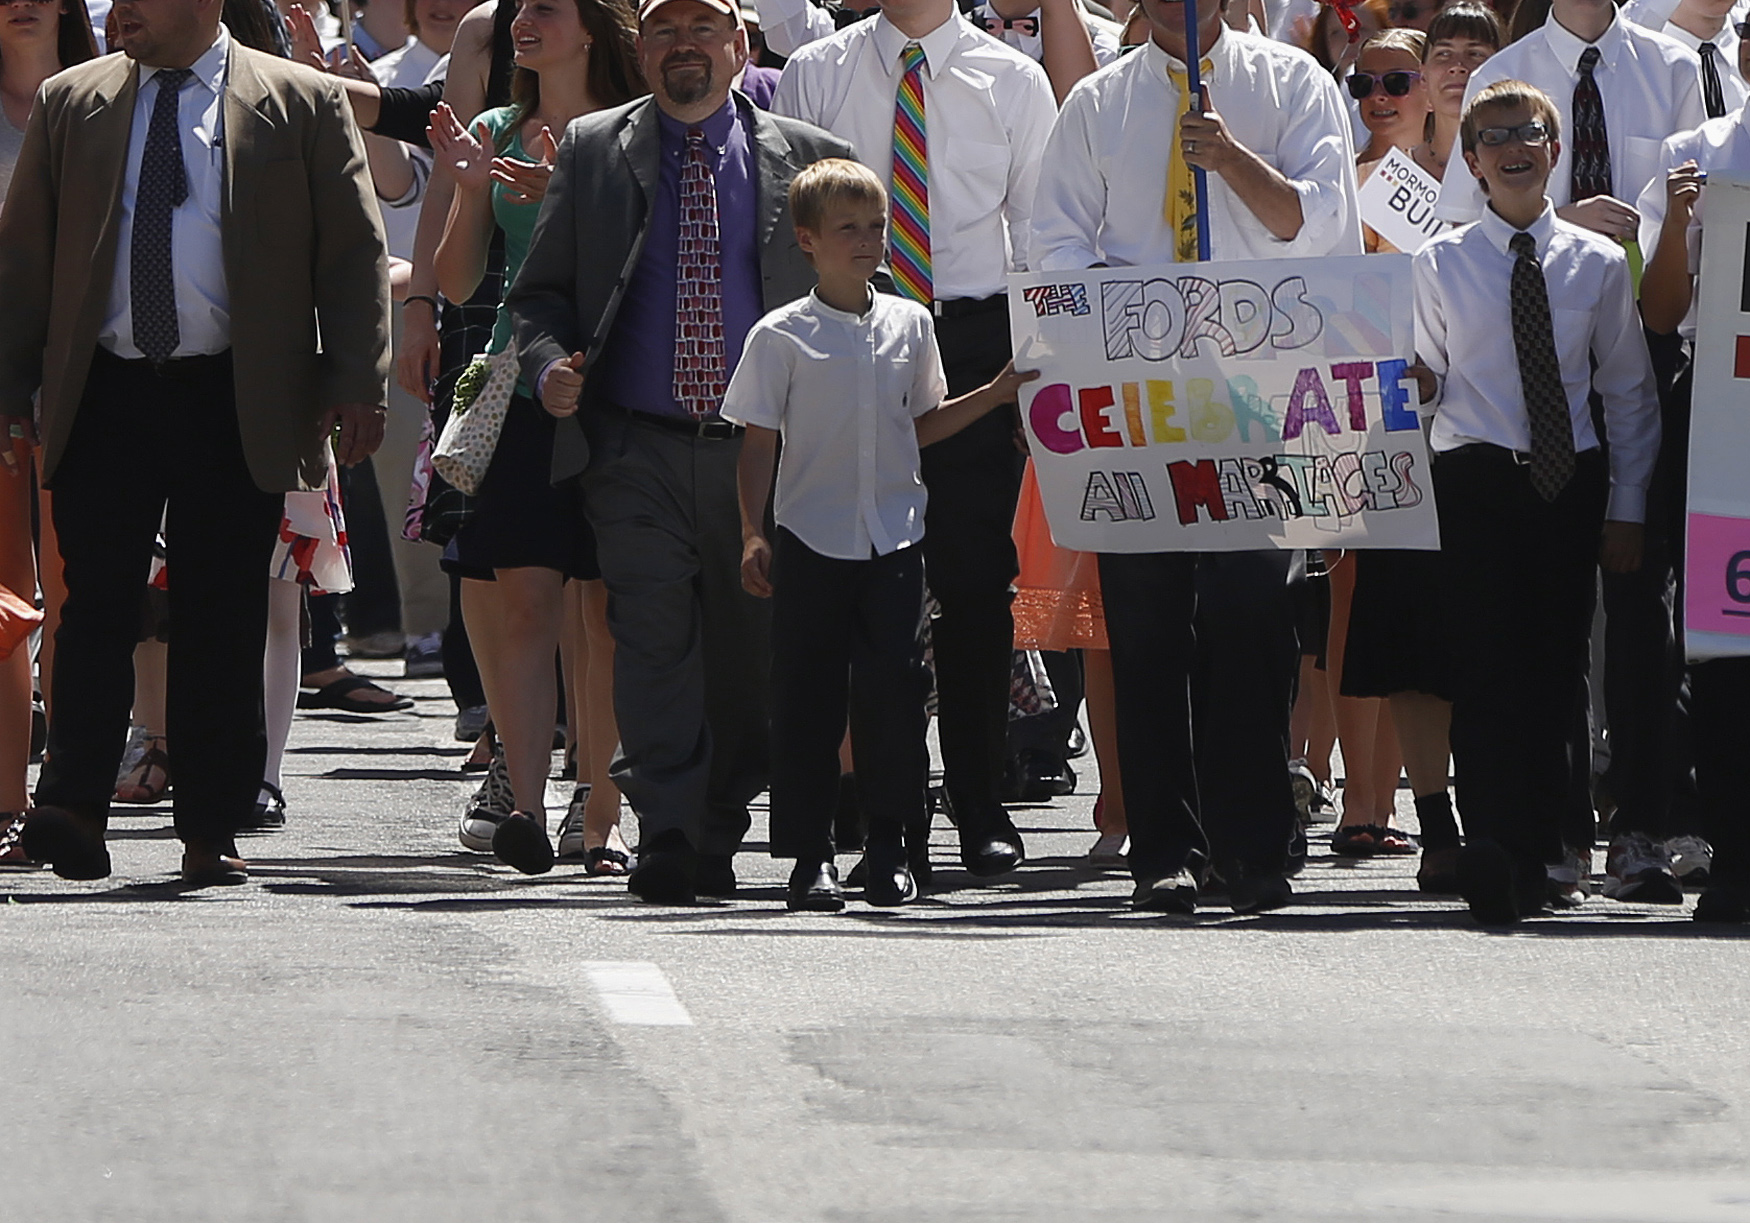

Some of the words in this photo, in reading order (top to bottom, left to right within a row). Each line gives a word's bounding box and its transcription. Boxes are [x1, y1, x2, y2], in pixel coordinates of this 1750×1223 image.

[1385, 157, 1438, 204] MORMO
[1023, 283, 1092, 318] THE
[1101, 276, 1323, 362] FORDS
